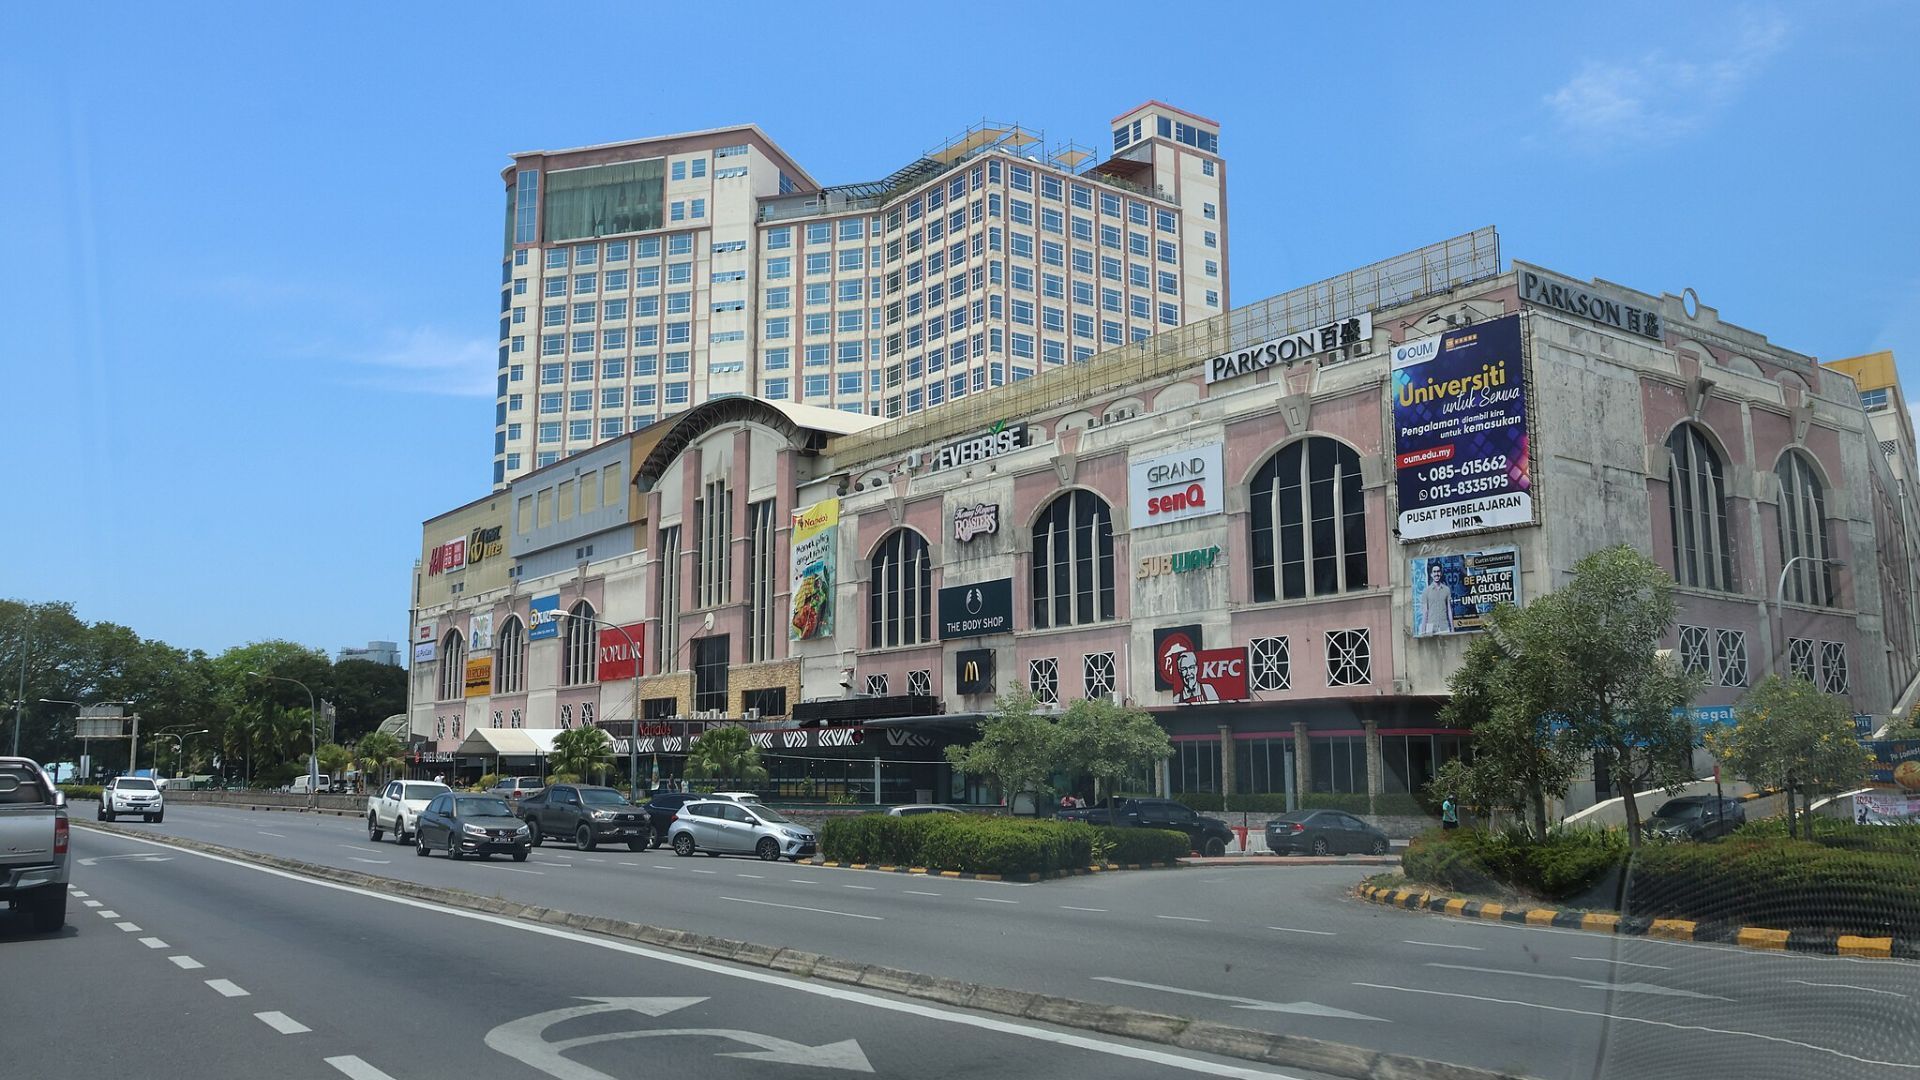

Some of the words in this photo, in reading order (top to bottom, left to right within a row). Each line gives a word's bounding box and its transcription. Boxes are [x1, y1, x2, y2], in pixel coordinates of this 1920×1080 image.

[1525, 272, 1621, 326] PARKSON
[1625, 306, 1660, 338] 百盛
[1212, 333, 1314, 380] PARKSON
[1318, 318, 1361, 350] 百盛
[1408, 342, 1432, 358] OUM
[1400, 360, 1505, 407] Universiti
[1443, 386, 1476, 415] untuk
[1479, 386, 1520, 408] Semua
[1401, 418, 1459, 437] Pengalaman
[1462, 410, 1489, 424] diambil
[1490, 409, 1505, 419] kira
[1440, 427, 1462, 439] untuk
[1464, 415, 1521, 434] kemasukan
[939, 427, 1021, 469] EVERRISE
[1403, 449, 1451, 464] oum.edu.my
[1147, 457, 1205, 483] GRAND
[1429, 455, 1507, 481] 085-615662
[1148, 483, 1206, 516] senQ
[1430, 474, 1509, 500] 013-8335195
[1407, 509, 1438, 524] PUSAT
[1440, 496, 1521, 518] PEMBELAJARAN
[1452, 516, 1474, 529] MIRI
[1136, 545, 1220, 580] SUBWAY
[1464, 577, 1475, 586] BE
[1476, 572, 1498, 584] PART
[1499, 571, 1512, 581] OF
[1470, 586, 1477, 594] A
[1478, 582, 1512, 593] GLOBAL
[1462, 592, 1513, 605] UNIVERSITY
[947, 621, 960, 632] THE
[963, 619, 982, 631] BODY
[983, 616, 1004, 628] SHOP
[600, 641, 642, 664] POPULAR
[1201, 659, 1243, 679] KFC
